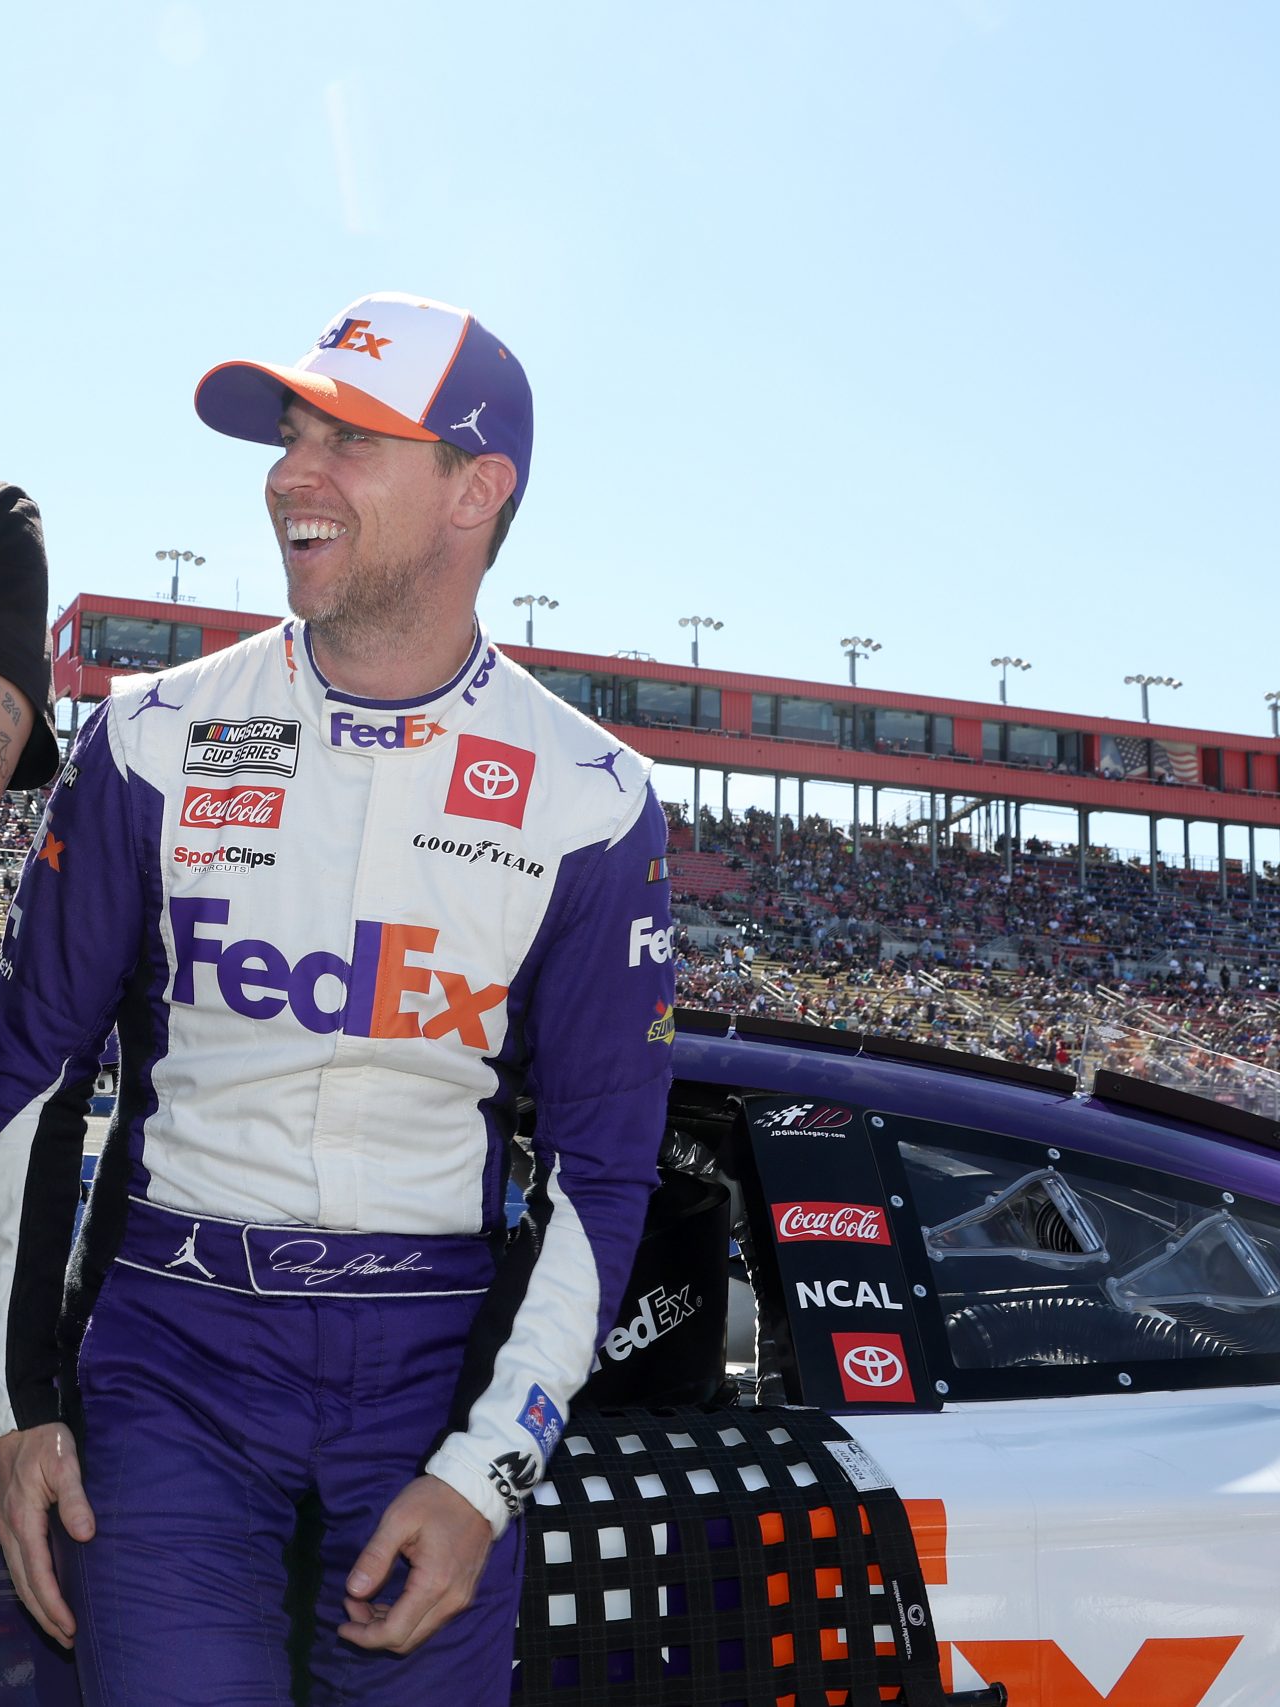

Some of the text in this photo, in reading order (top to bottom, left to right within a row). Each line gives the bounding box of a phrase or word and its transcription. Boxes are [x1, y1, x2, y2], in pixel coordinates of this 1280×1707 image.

[319, 318, 393, 361] dEx
[225, 723, 284, 742] NASCAR
[330, 711, 448, 750] FedEx
[202, 745, 281, 763] CUP SERIES
[193, 863, 247, 874] HAIRCUTS
[169, 897, 510, 1051] FedEx
[770, 1129, 846, 1139] JDGibbsLegacy.com
[780, 1205, 881, 1240] Coca-Cola
[795, 1280, 904, 1310] NCAL
